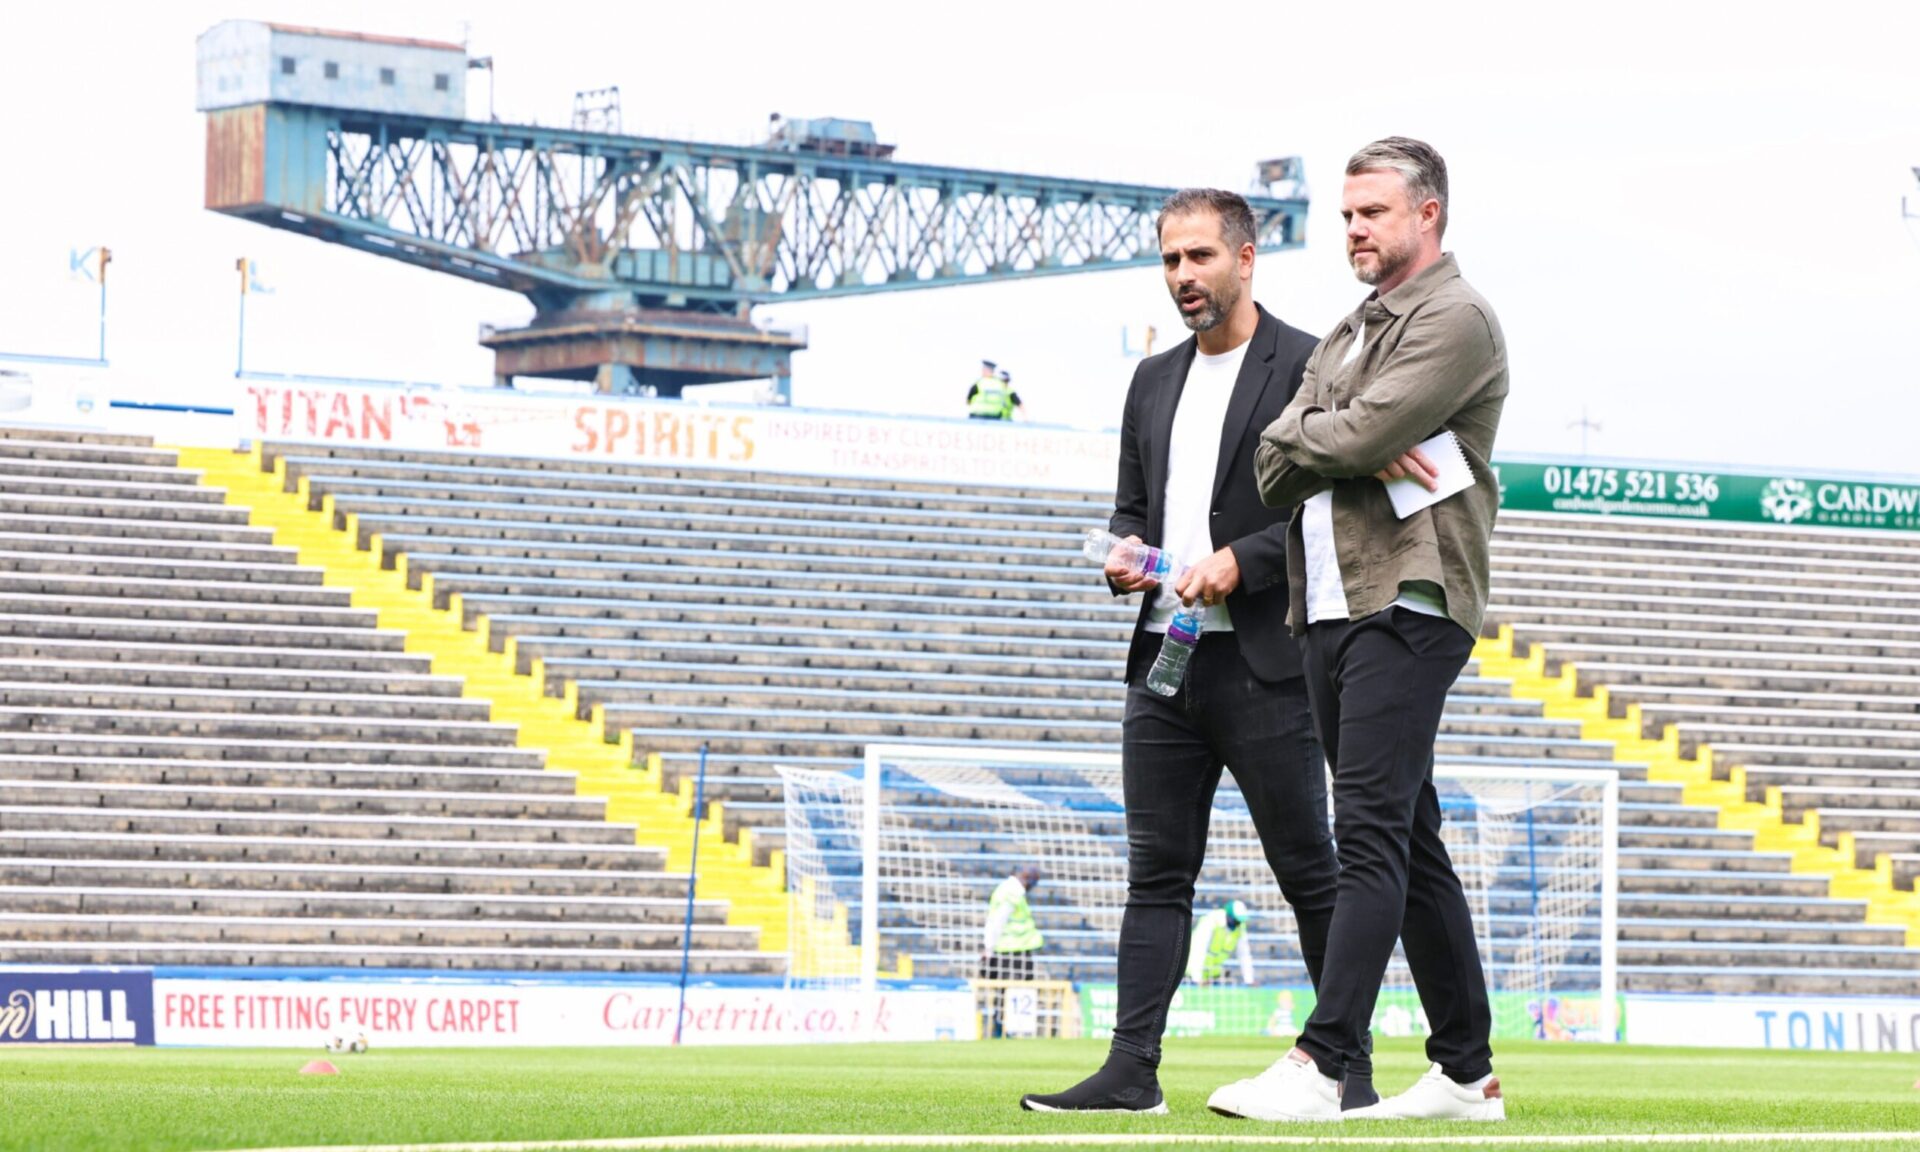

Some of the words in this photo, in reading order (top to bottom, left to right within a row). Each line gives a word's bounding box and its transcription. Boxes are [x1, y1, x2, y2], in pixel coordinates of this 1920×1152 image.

[246, 386, 393, 442] TITAN
[570, 405, 756, 461] SPIRITS
[767, 419, 862, 444] INSPIRED
[867, 425, 893, 445] BY
[899, 426, 1007, 455] CLYDESIDE
[832, 448, 1052, 479] TITANSPIRITSLTDCOM
[1543, 466, 1618, 497] 01475
[1624, 470, 1666, 499] 521
[1675, 473, 1719, 502] 536
[1817, 483, 1920, 514] CARDW
[35, 989, 136, 1039] HILL
[164, 993, 225, 1029] FREE
[235, 995, 331, 1031] FITTING
[339, 996, 418, 1032] EVERY
[426, 998, 520, 1033] CARPET
[1010, 994, 1033, 1016] 12
